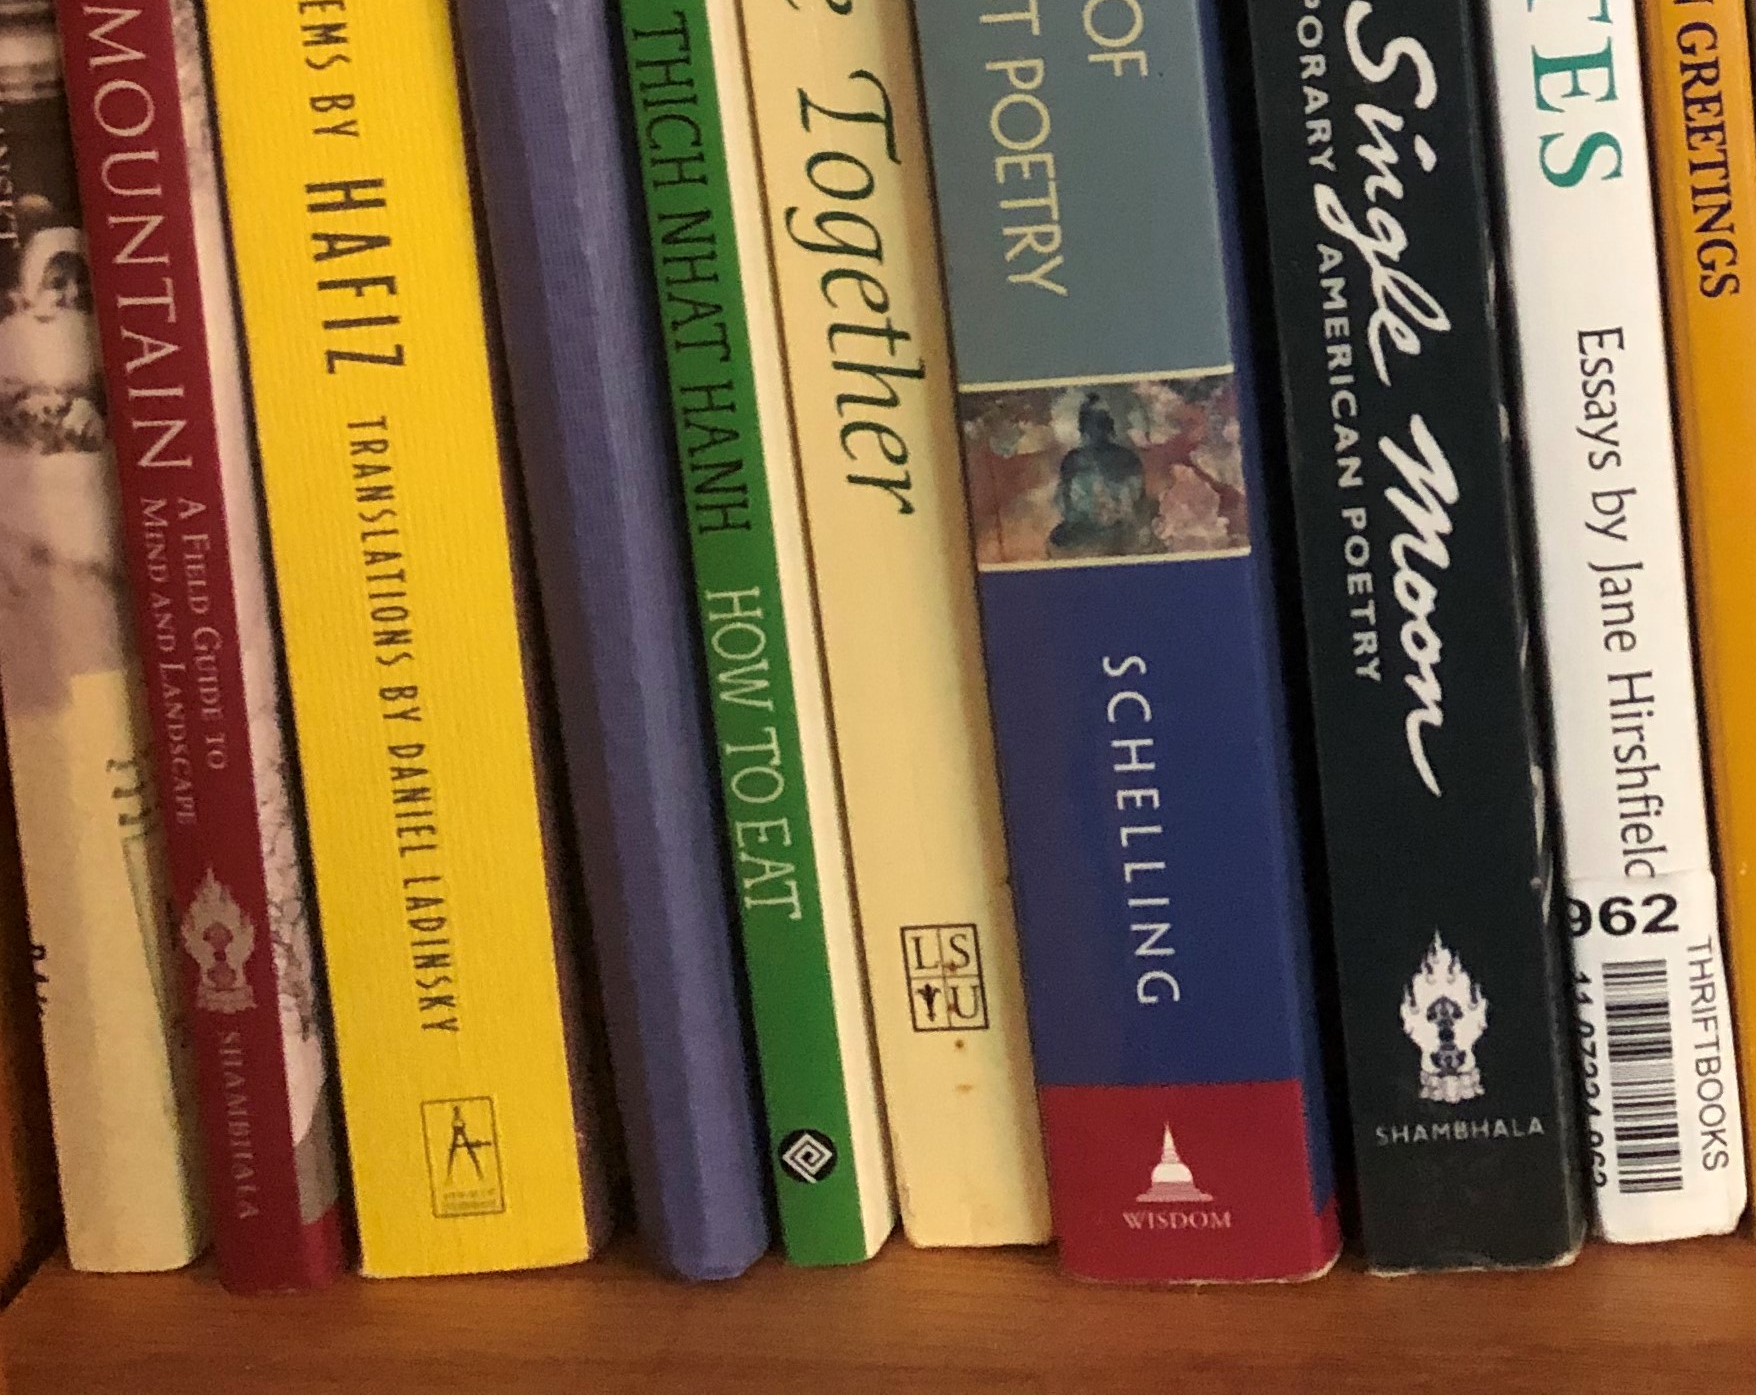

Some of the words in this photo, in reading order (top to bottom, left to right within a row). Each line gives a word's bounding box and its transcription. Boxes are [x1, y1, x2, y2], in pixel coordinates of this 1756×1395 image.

[309, 93, 359, 139] BY
[631, 10, 708, 188] THICH
[1675, 20, 1740, 299] GREETINGS
[82, 5, 193, 469] MOUNTAIN
[985, 58, 1068, 297] POETRY
[1312, 0, 1451, 387] Single
[304, 177, 405, 375] HAFIZ
[656, 209, 731, 364] NHAT
[784, 69, 926, 515] Together
[681, 380, 752, 535] HANH
[1315, 243, 1364, 488] AMERICAN
[1341, 507, 1384, 683] POETRY
[1576, 326, 1625, 472] Essays
[178, 498, 207, 520] A
[347, 414, 415, 668] TRANSLATIONS
[1585, 487, 1637, 542] by
[705, 585, 774, 713] HOW
[1378, 413, 1459, 798] Moon
[1588, 561, 1644, 652] Jane
[379, 684, 423, 723] BY
[725, 727, 785, 804] TO
[386, 743, 440, 859] DANIEL
[735, 817, 802, 921] EAT
[1102, 655, 1180, 1005] SCHELLING
[403, 875, 460, 1034] LADINSKY
[1565, 893, 1679, 938] 962
[217, 1029, 259, 1221] SHAMBHALA
[1687, 934, 1729, 1172] THRIFTBOOKS
[1376, 1117, 1545, 1147] SHAMBHALA
[1122, 1208, 1232, 1232] WISDOM
